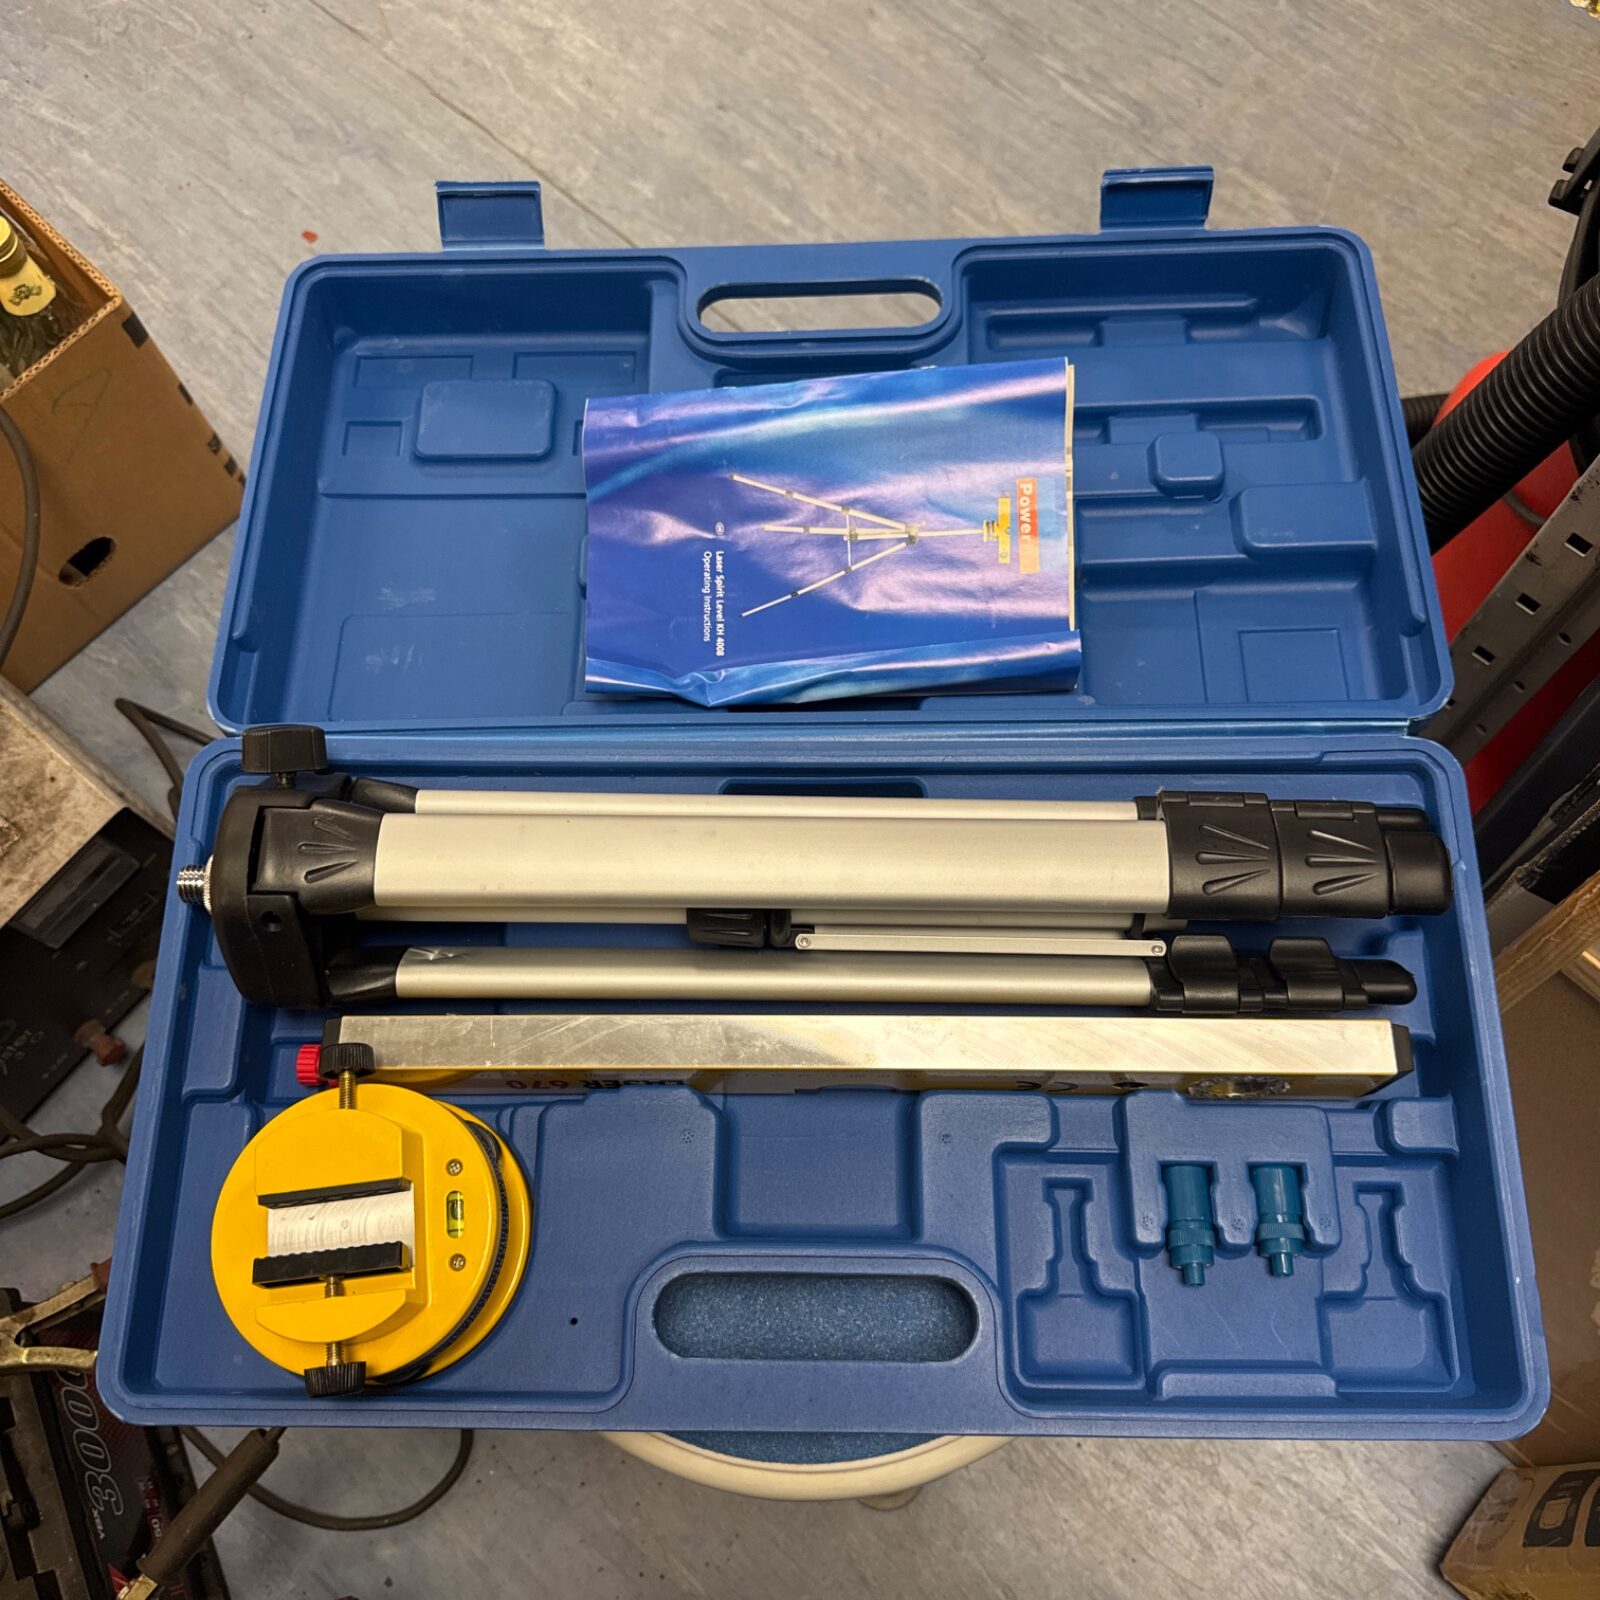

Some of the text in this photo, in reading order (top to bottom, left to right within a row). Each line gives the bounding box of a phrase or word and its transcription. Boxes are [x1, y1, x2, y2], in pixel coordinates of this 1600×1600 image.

[702, 551, 712, 642] Operating Instructions
[714, 551, 725, 656] Laser Spirit Level KH 4008
[505, 1080, 569, 1090] 670
